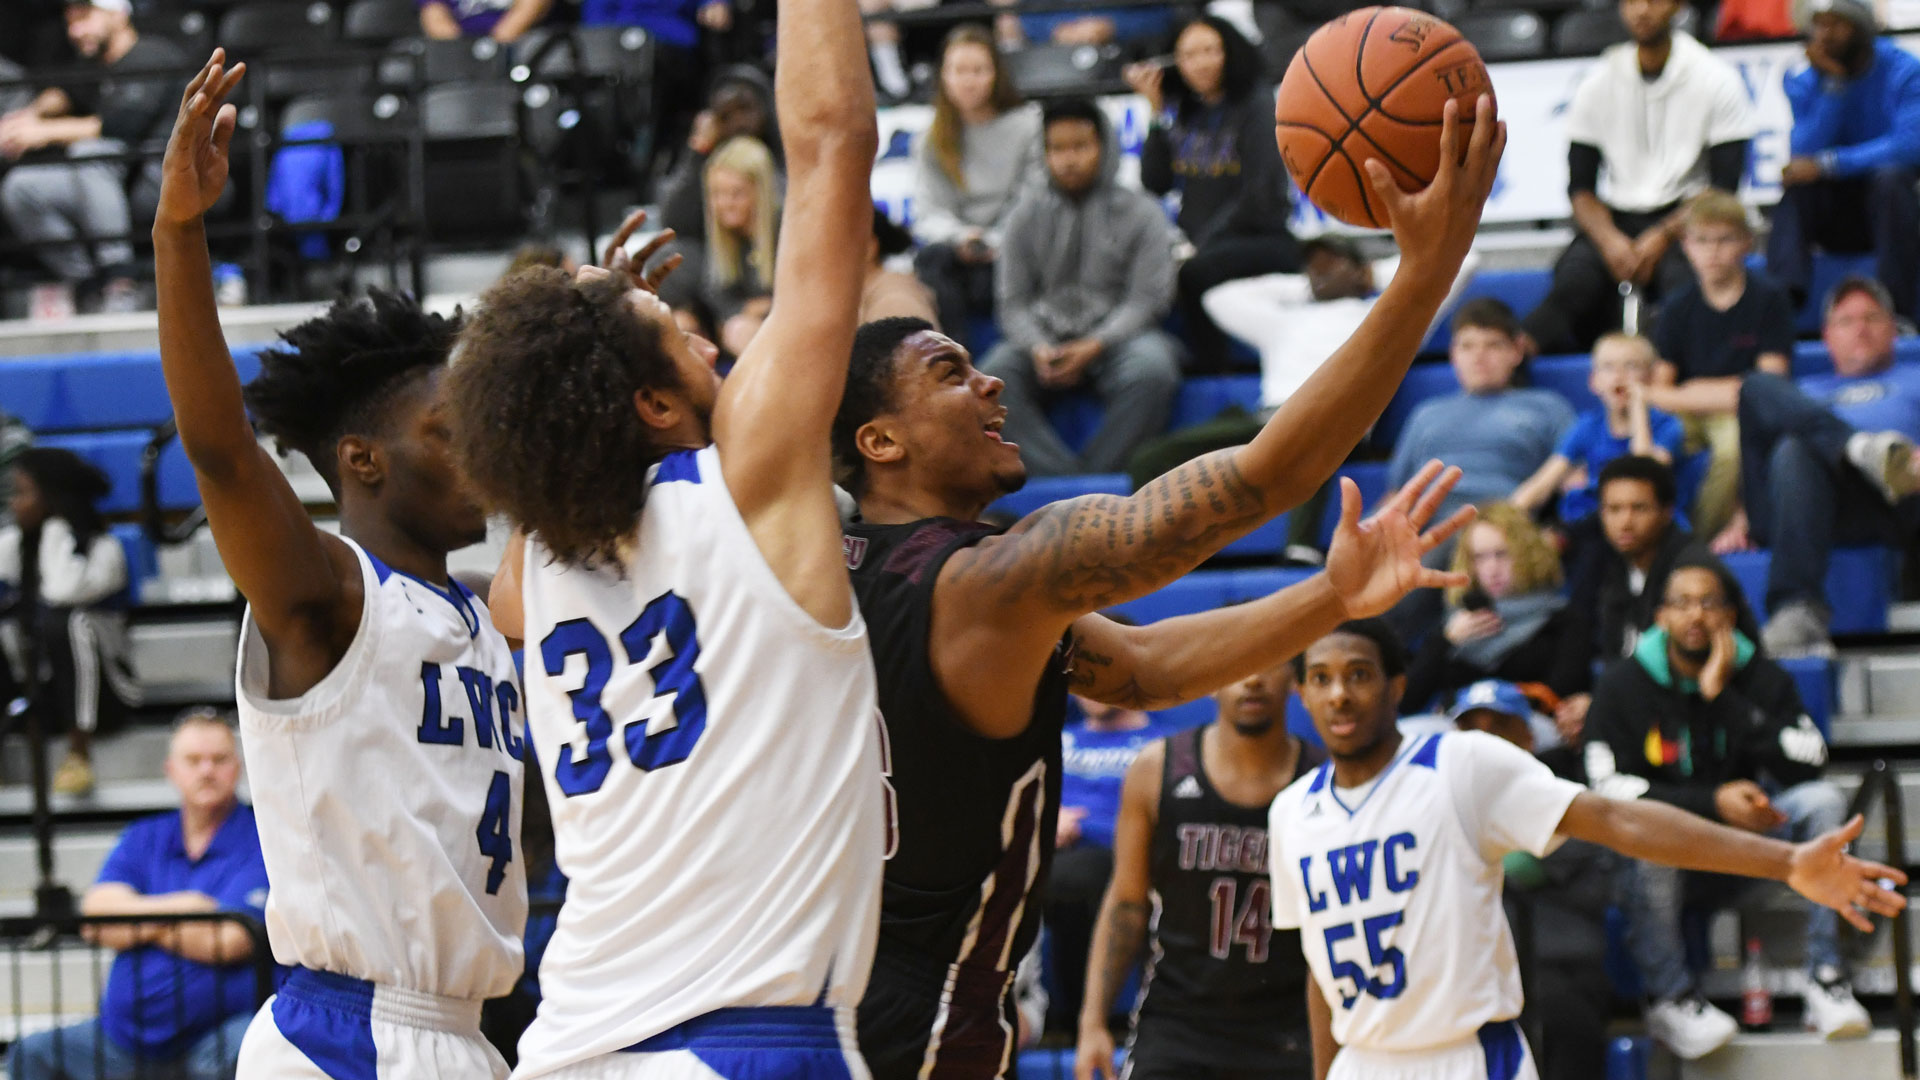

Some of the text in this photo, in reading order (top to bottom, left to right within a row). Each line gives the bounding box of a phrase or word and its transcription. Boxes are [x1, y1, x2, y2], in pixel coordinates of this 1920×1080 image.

[417, 661, 523, 762] LWC
[540, 588, 707, 798] 33
[476, 769, 512, 896] 4
[1300, 831, 1419, 914] LWC
[1208, 877, 1273, 964] 14
[1323, 910, 1407, 1010] 55
